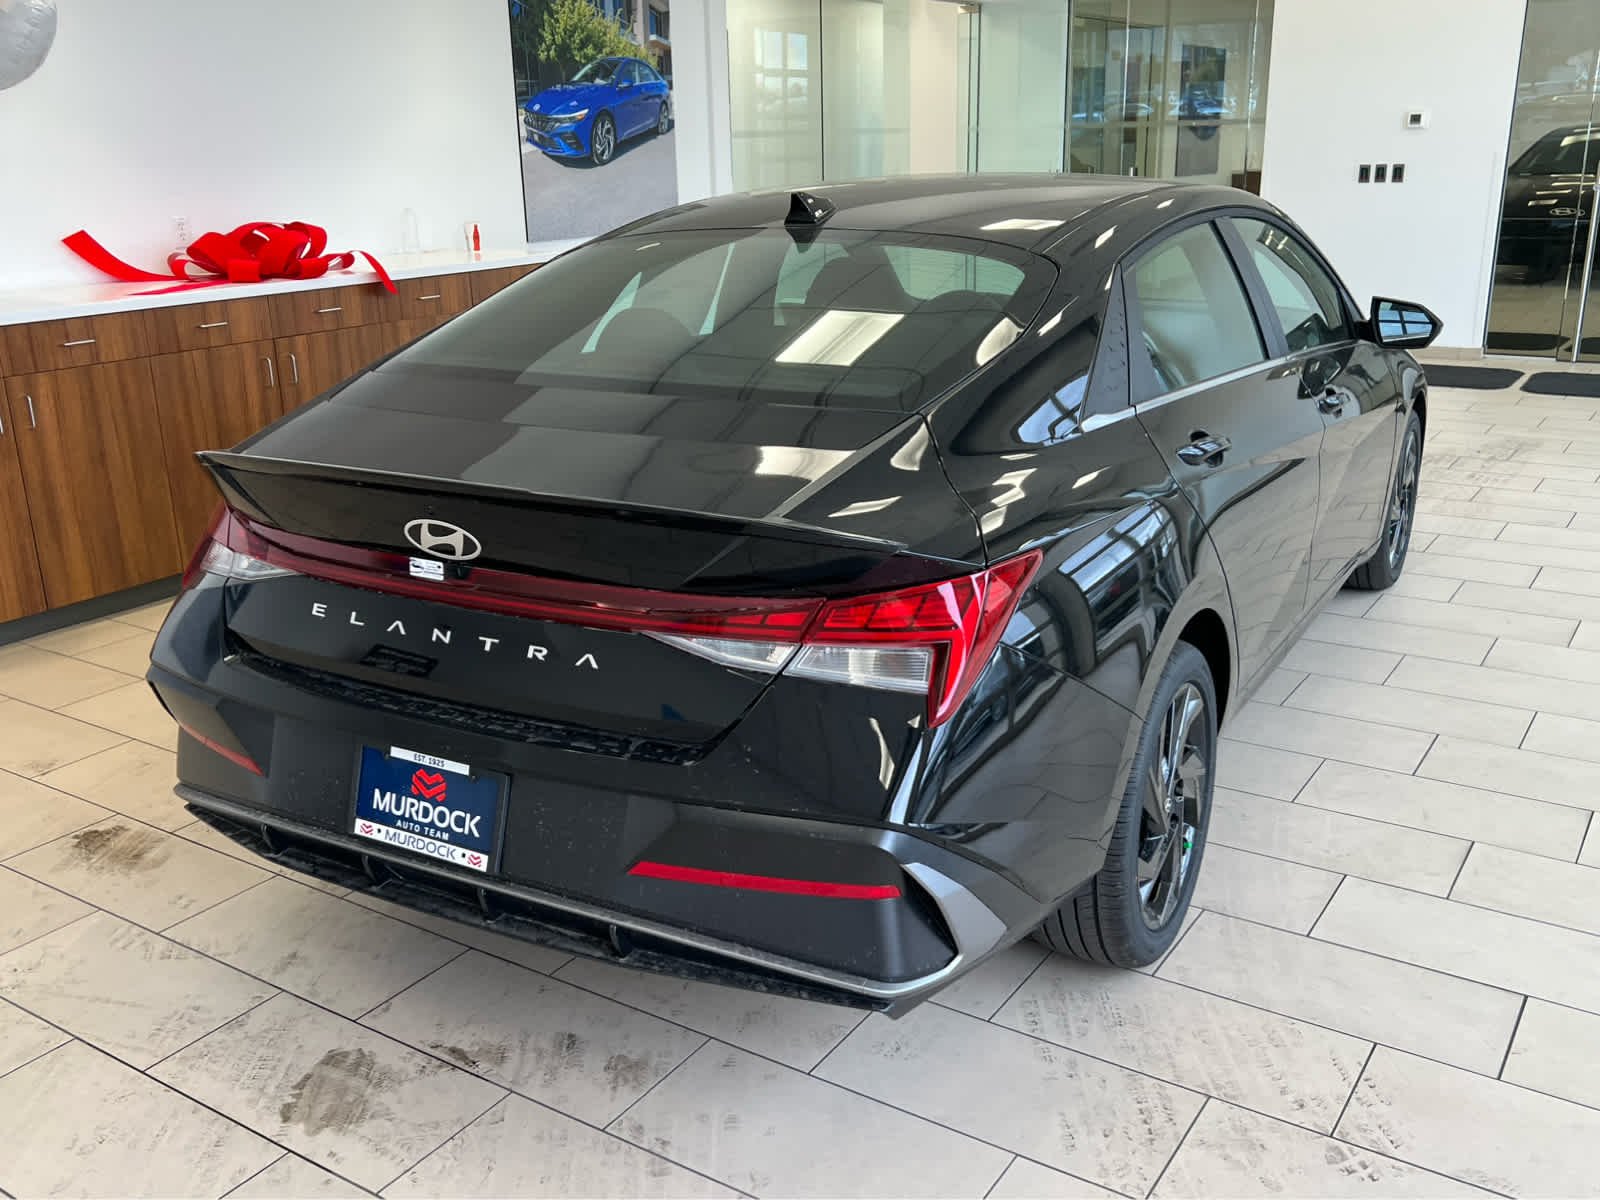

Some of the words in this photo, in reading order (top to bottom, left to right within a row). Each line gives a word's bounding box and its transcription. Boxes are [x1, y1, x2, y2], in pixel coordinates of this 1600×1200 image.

[311, 602, 600, 671] ELANTRA
[413, 753, 427, 763] EST.
[428, 756, 446, 768] 1925
[372, 788, 482, 838] MURDOCK
[384, 828, 458, 861] MURDOCK
[396, 819, 421, 833] AUTO
[424, 827, 450, 841] TEAM
